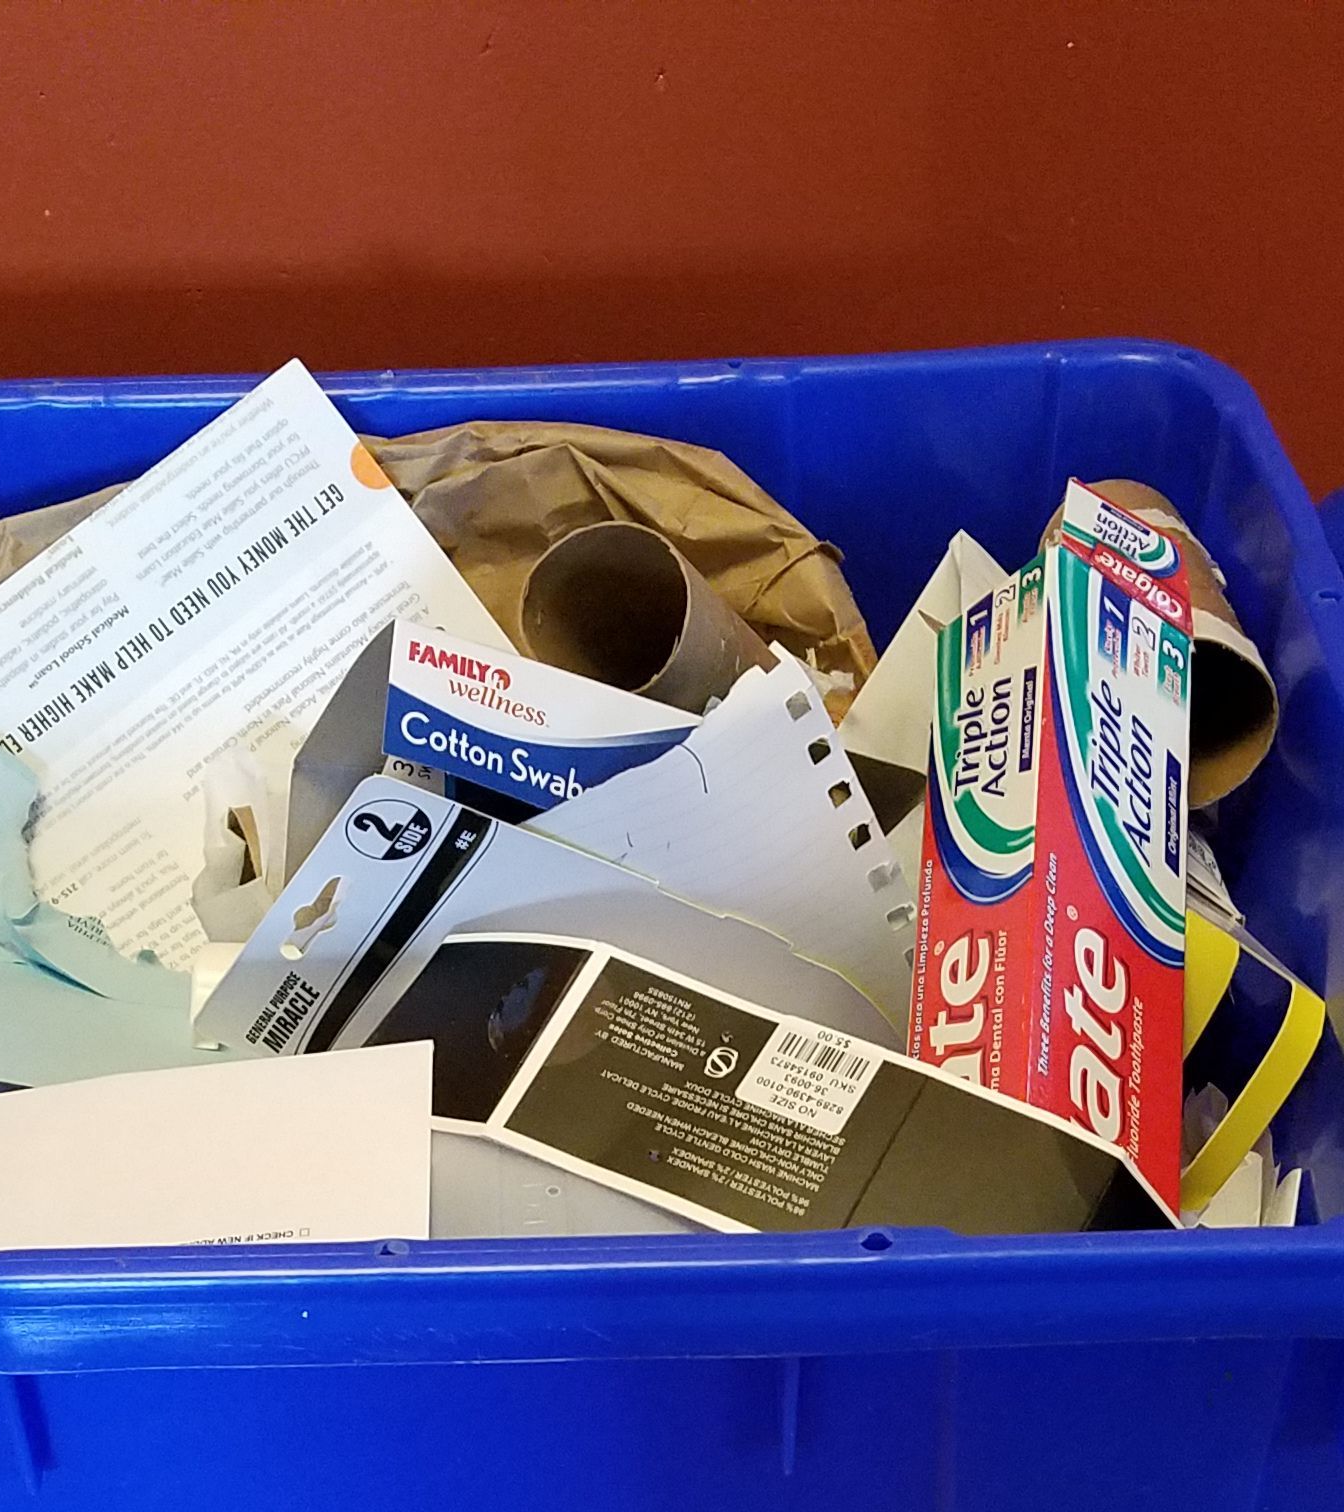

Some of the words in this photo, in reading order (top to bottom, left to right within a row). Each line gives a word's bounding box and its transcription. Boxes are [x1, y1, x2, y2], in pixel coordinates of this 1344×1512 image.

[310, 480, 346, 515] GET
[281, 503, 317, 537] THE
[1096, 512, 1149, 549] Action
[233, 524, 289, 575] MONEY
[1092, 524, 1146, 559] Triple
[203, 562, 240, 598] YOU
[1022, 564, 1042, 588] 3
[1100, 551, 1183, 617] Colgate
[166, 585, 211, 628] NEED
[995, 583, 1015, 608] 2
[1102, 595, 1127, 622] 1
[89, 603, 130, 639] Medical
[145, 614, 174, 644] TO
[970, 606, 989, 624] 1
[1130, 616, 1157, 648] 2
[56, 632, 93, 664] School
[109, 631, 153, 672] HELP
[405, 640, 491, 682] FAMILY
[1160, 639, 1187, 668] 3
[68, 659, 116, 704] MAKE
[1021, 679, 1036, 722] Original
[16, 691, 76, 745] HIGHER
[447, 677, 548, 727] wellness
[954, 684, 985, 795] Triple
[980, 674, 1017, 796] Action
[1091, 679, 1122, 806] Triple
[401, 708, 505, 774] Cotton
[507, 749, 585, 802] Swab
[1121, 715, 1153, 867] Action
[353, 811, 404, 846] 2
[393, 818, 428, 856] SIDE
[1162, 806, 1181, 854] Original
[919, 859, 934, 916] Profunda
[1045, 852, 1057, 894] Clean
[1044, 897, 1057, 935] Deep
[915, 918, 931, 973] Limpieza
[993, 929, 1009, 971] Flúor
[1041, 948, 1054, 971] for
[1044, 936, 1054, 947] a
[916, 975, 926, 1000] una
[994, 978, 1005, 1003] con
[1038, 971, 1053, 1032] Benefits
[245, 1006, 276, 1044] GENERAL
[268, 970, 301, 1009] PURPOSE
[260, 981, 322, 1053] MIRACLE
[912, 1002, 925, 1031] para
[815, 1028, 852, 1049] $5.00
[987, 1007, 1006, 1062] Dental
[1128, 996, 1147, 1092] Toothpaste
[1037, 1032, 1050, 1076] Three
[768, 1092, 797, 1110] SIZE
[828, 1076, 857, 1094] SKU
[796, 1103, 818, 1119] NO
[256, 1229, 293, 1241] CHECK
